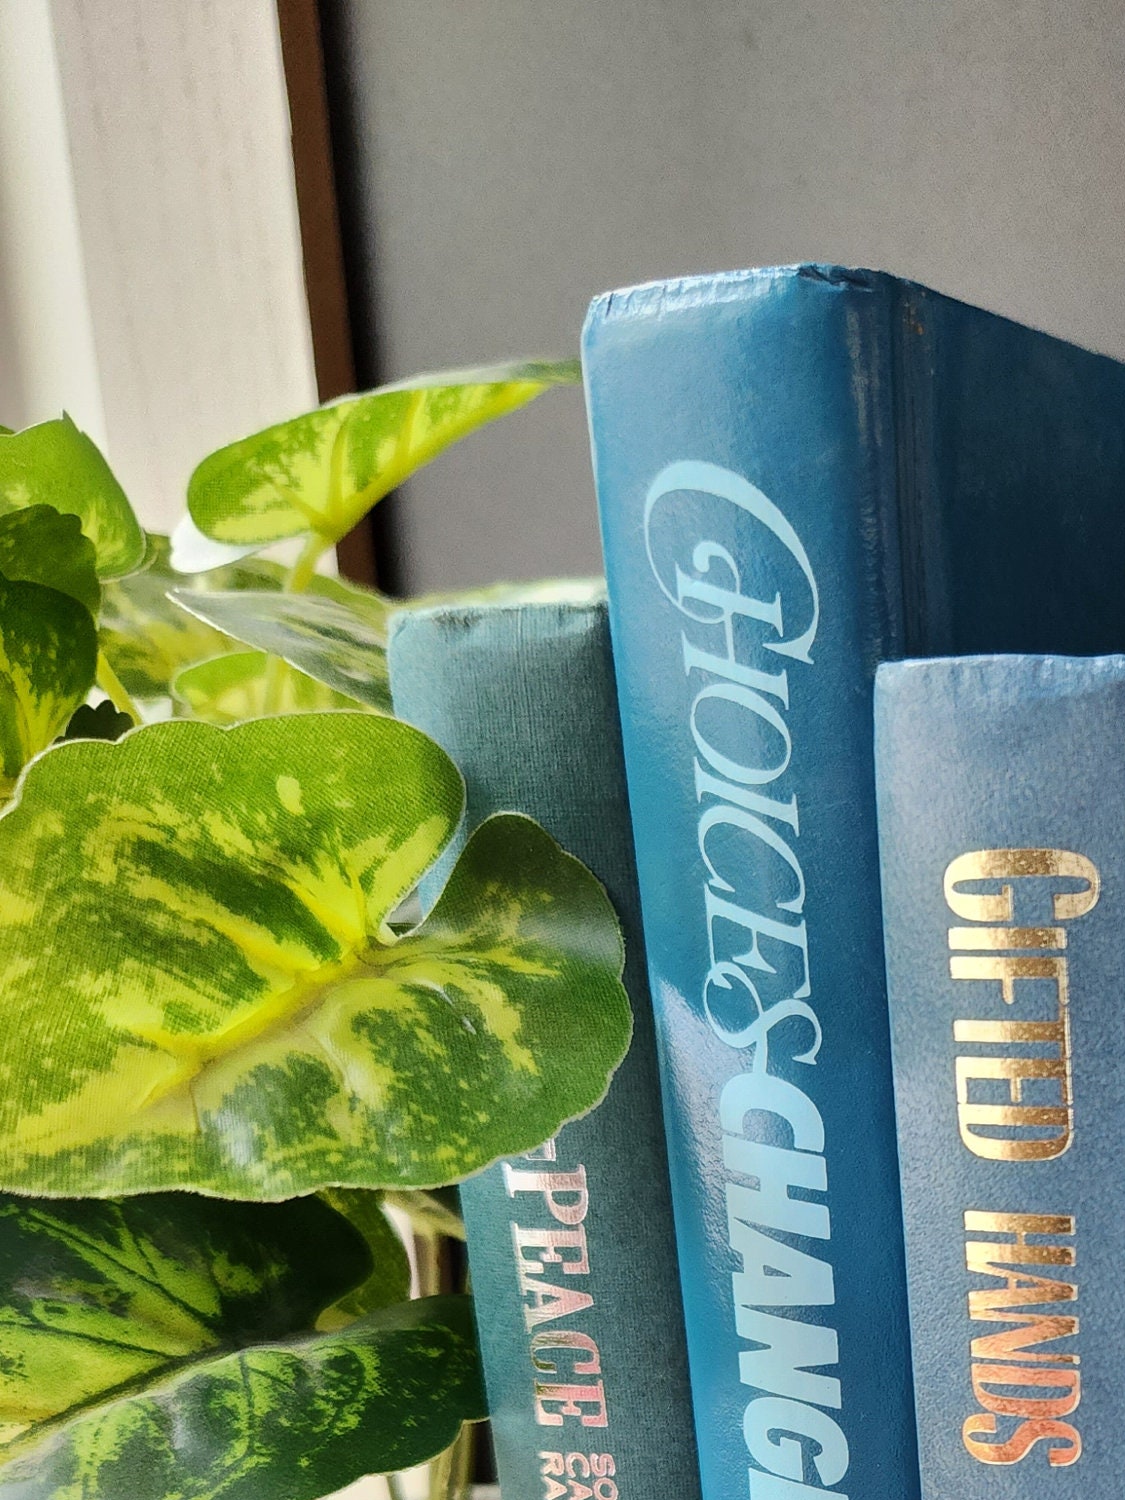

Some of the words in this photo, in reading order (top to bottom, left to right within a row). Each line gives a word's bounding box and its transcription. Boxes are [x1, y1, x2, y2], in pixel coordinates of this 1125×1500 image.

[943, 847, 1101, 1163] GIFTED
[502, 1163, 608, 1427] PEACE
[962, 1210, 1082, 1468] HANDS
